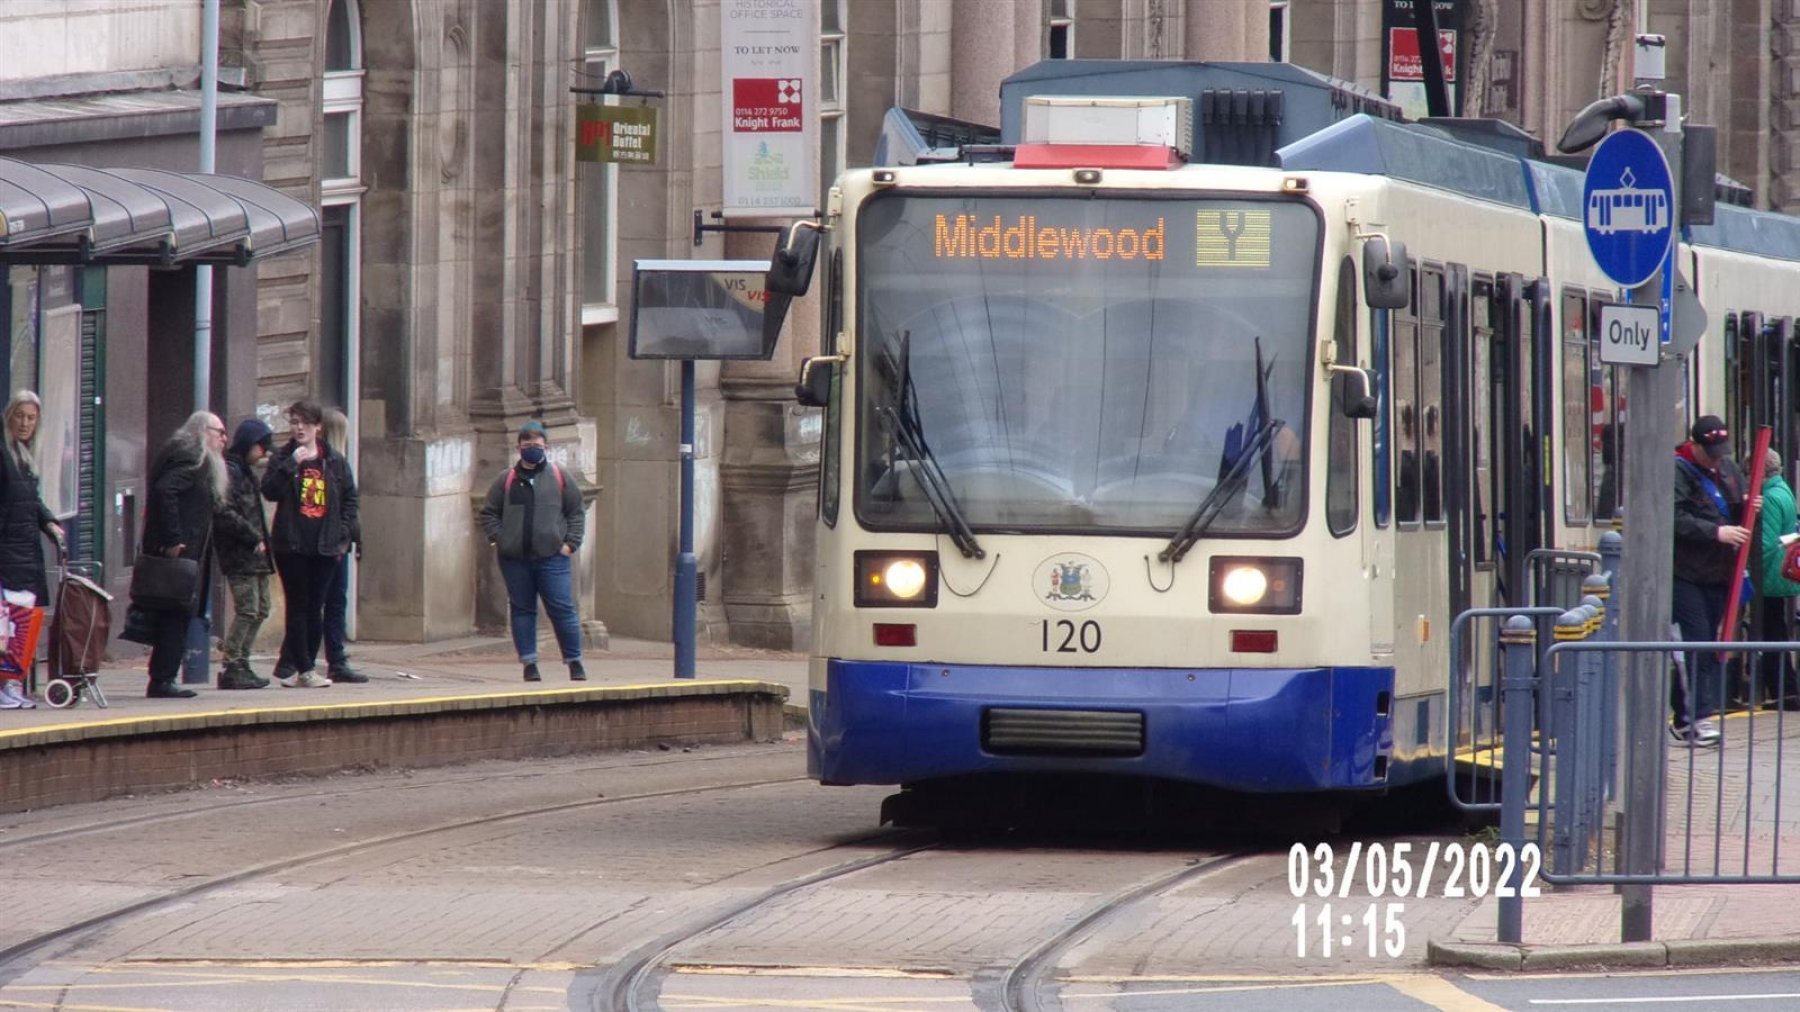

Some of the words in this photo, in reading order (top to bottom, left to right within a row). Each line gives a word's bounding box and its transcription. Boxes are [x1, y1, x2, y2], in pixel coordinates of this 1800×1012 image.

[736, 0, 795, 9] HISTORICAL
[1394, 1, 1409, 9] TO
[729, 9, 768, 19] OFFICE
[770, 9, 803, 19] SPACE
[734, 46, 749, 55] TO
[752, 46, 772, 55] LET
[774, 45, 800, 54] NOW
[1393, 63, 1423, 75] Knight
[735, 107, 753, 116] 0114
[754, 107, 768, 116] 272
[613, 122, 651, 136] Oriental
[735, 116, 768, 130] Knight
[772, 116, 801, 128] Frank
[612, 135, 642, 149] Buffet
[935, 214, 1165, 260] Middlewood
[724, 278, 746, 291] VIS
[1609, 319, 1650, 351] Only
[1042, 619, 1102, 653] 120
